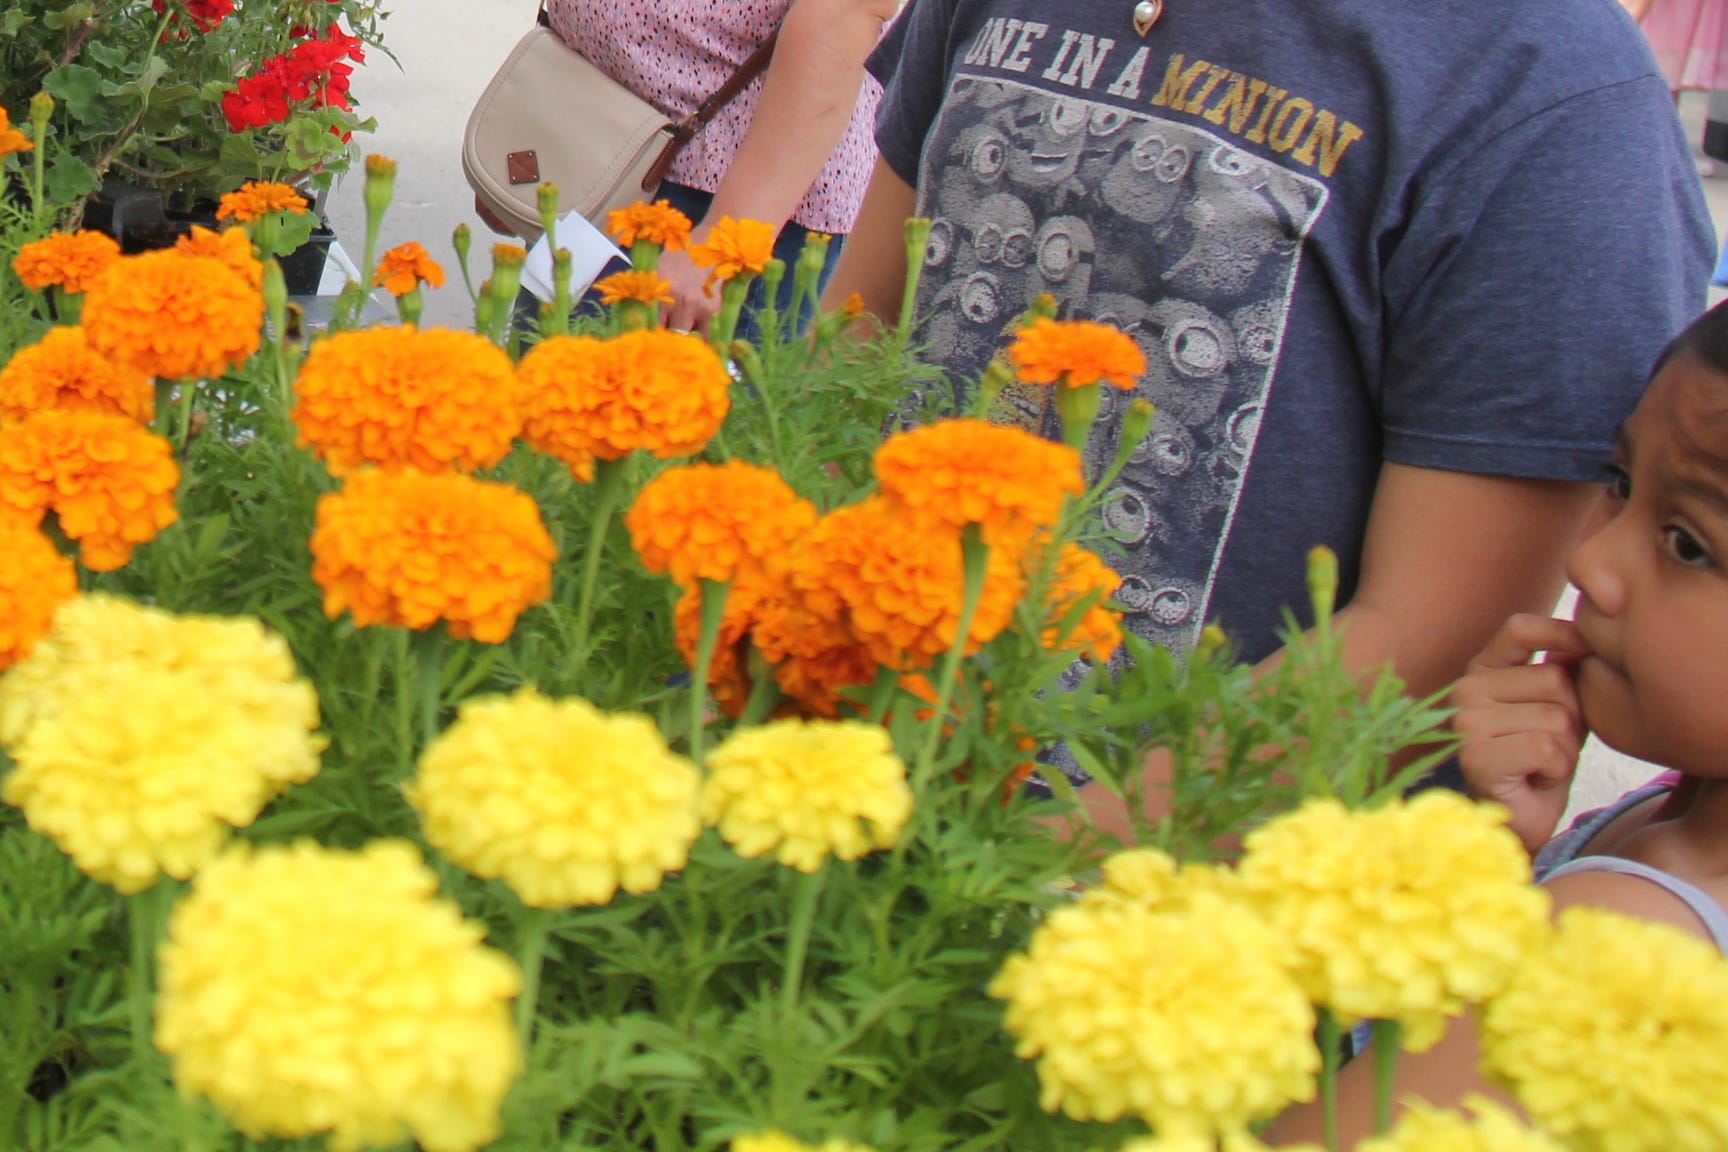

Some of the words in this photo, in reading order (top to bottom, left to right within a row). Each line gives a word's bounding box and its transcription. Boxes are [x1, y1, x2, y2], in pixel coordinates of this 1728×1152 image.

[963, 16, 1049, 74] ONE
[1041, 28, 1117, 90] IN
[1105, 45, 1152, 101] A
[1149, 53, 1364, 179] MINION
